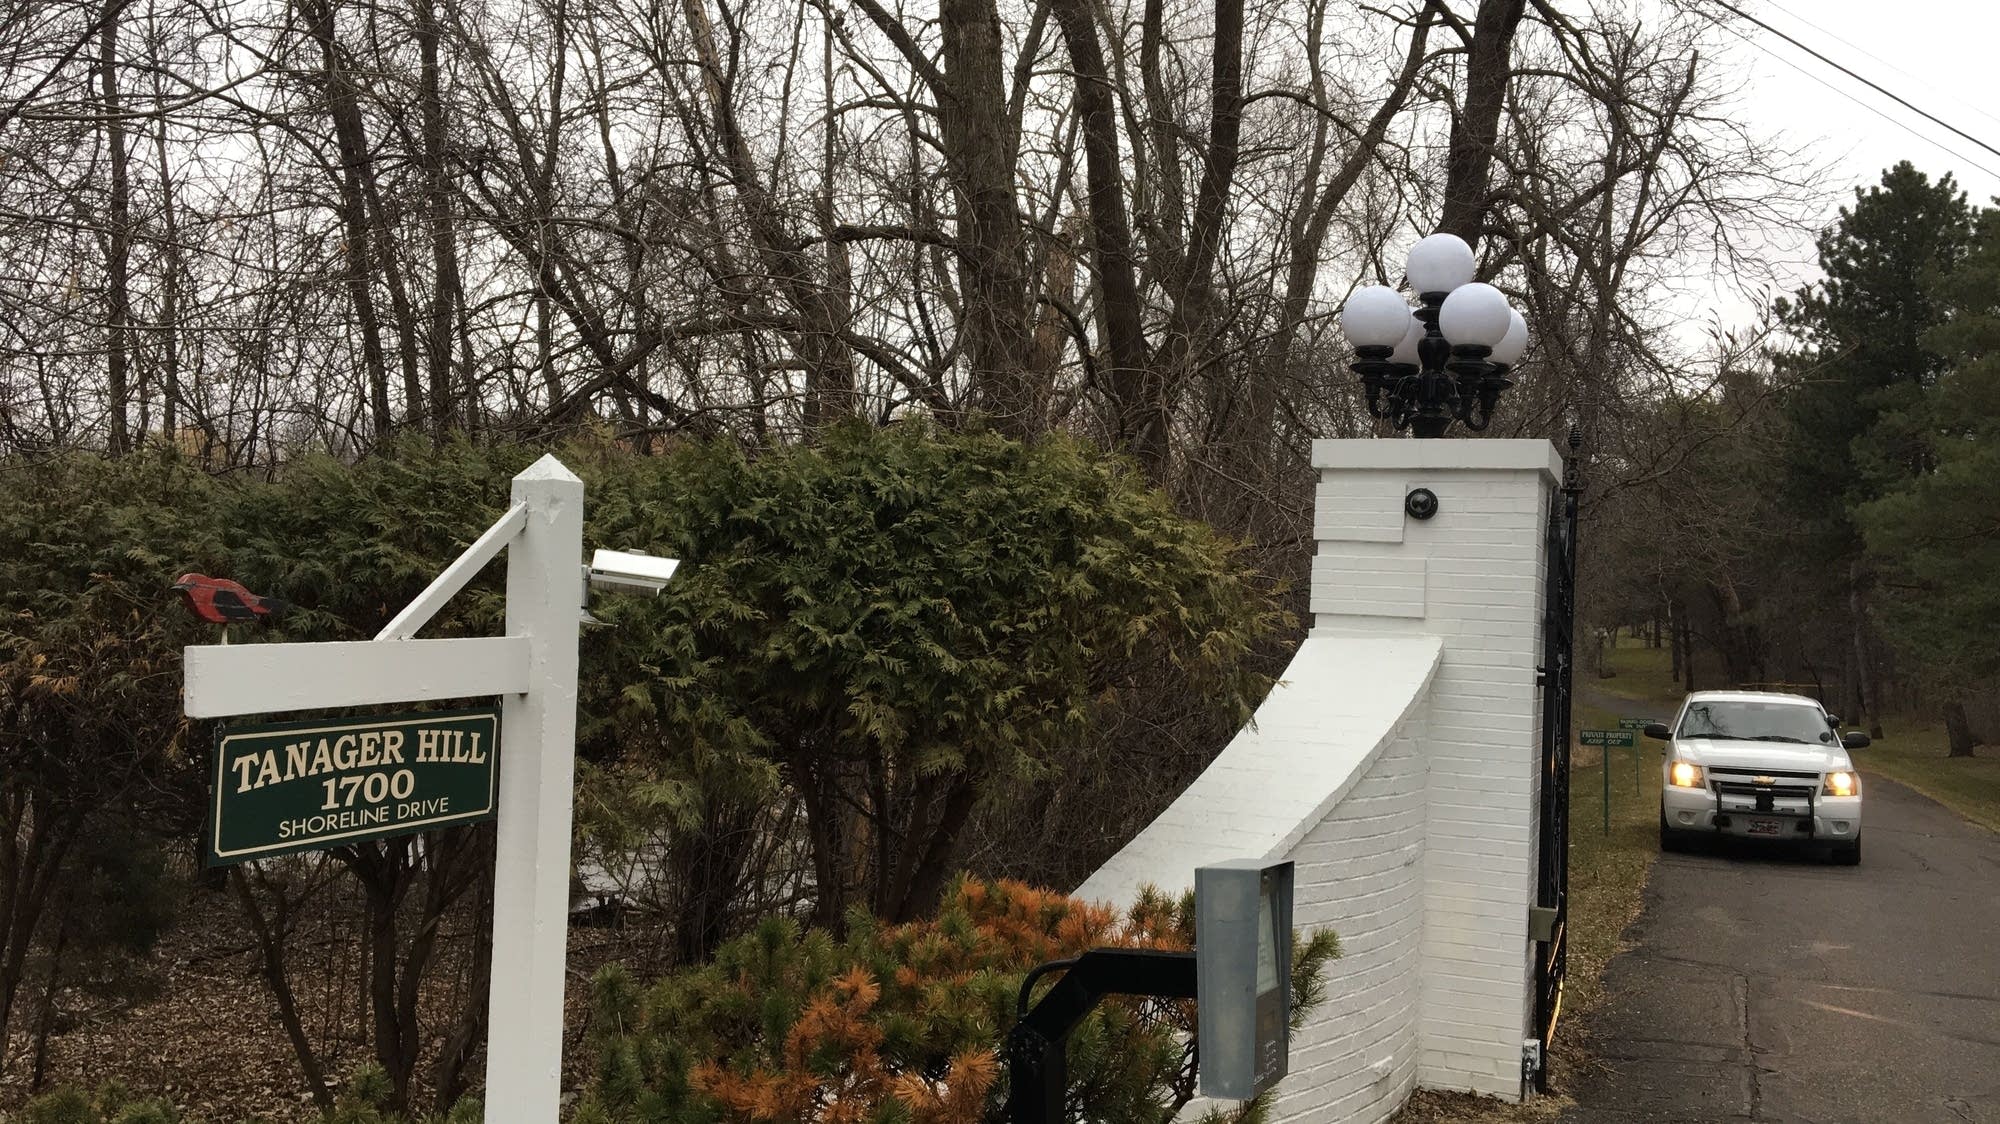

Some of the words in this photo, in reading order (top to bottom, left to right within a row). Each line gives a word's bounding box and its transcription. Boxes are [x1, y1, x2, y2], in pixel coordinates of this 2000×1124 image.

[232, 730, 404, 794] TANAGER
[416, 729, 487, 764] HILL
[321, 769, 415, 811] 1700
[278, 805, 390, 838] SHORELINE
[397, 797, 449, 820] DRIVE
